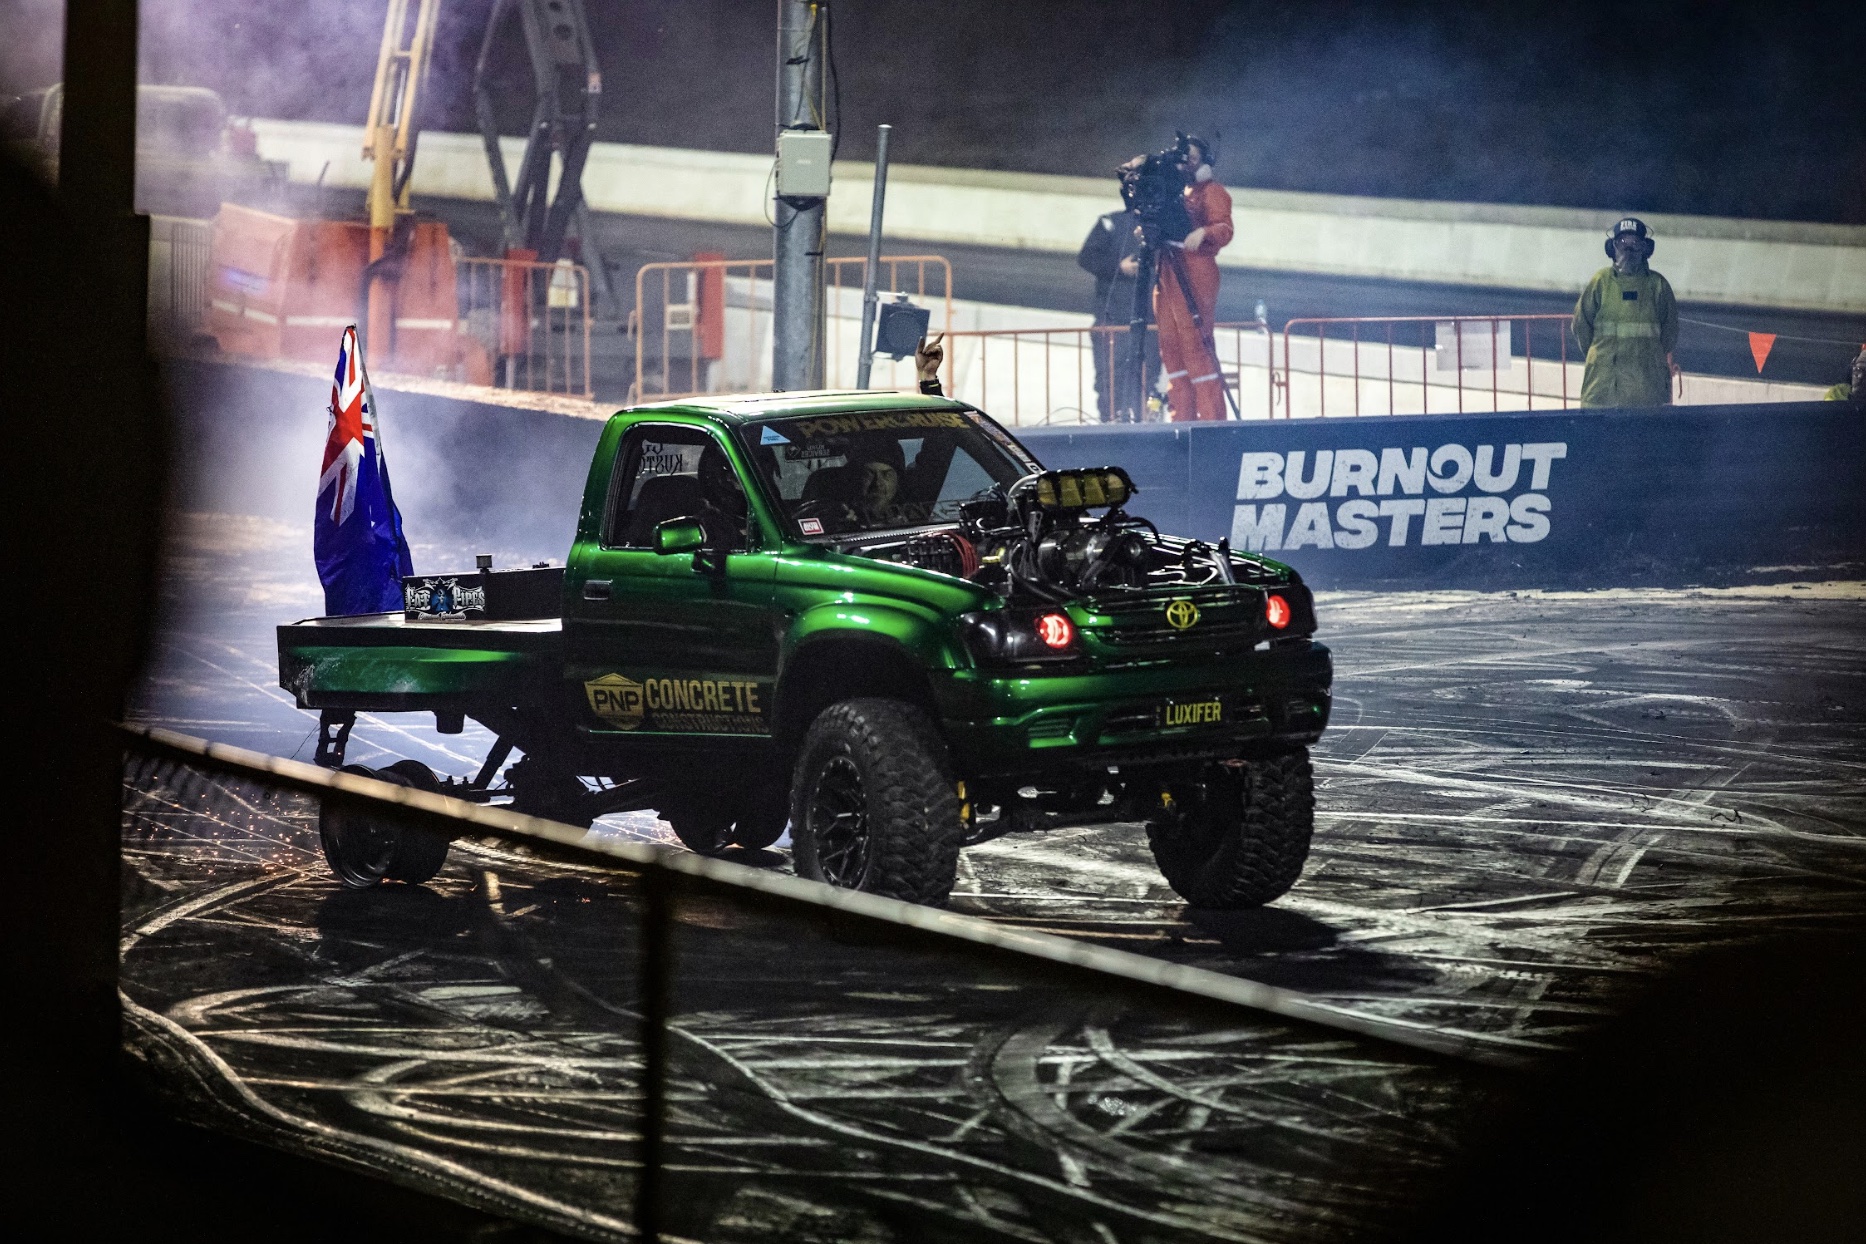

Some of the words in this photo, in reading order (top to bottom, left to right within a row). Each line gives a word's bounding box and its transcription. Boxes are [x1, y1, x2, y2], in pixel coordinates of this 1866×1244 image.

[796, 411, 971, 438] POWERCRUISE
[1236, 442, 1567, 500] BURNOUT
[1230, 493, 1551, 551] MASTERS
[593, 689, 641, 712] PNP
[644, 678, 761, 713] CONCRETE
[652, 712, 770, 733] CONSTRUCTIONS
[1166, 702, 1222, 725] LUXIFER
